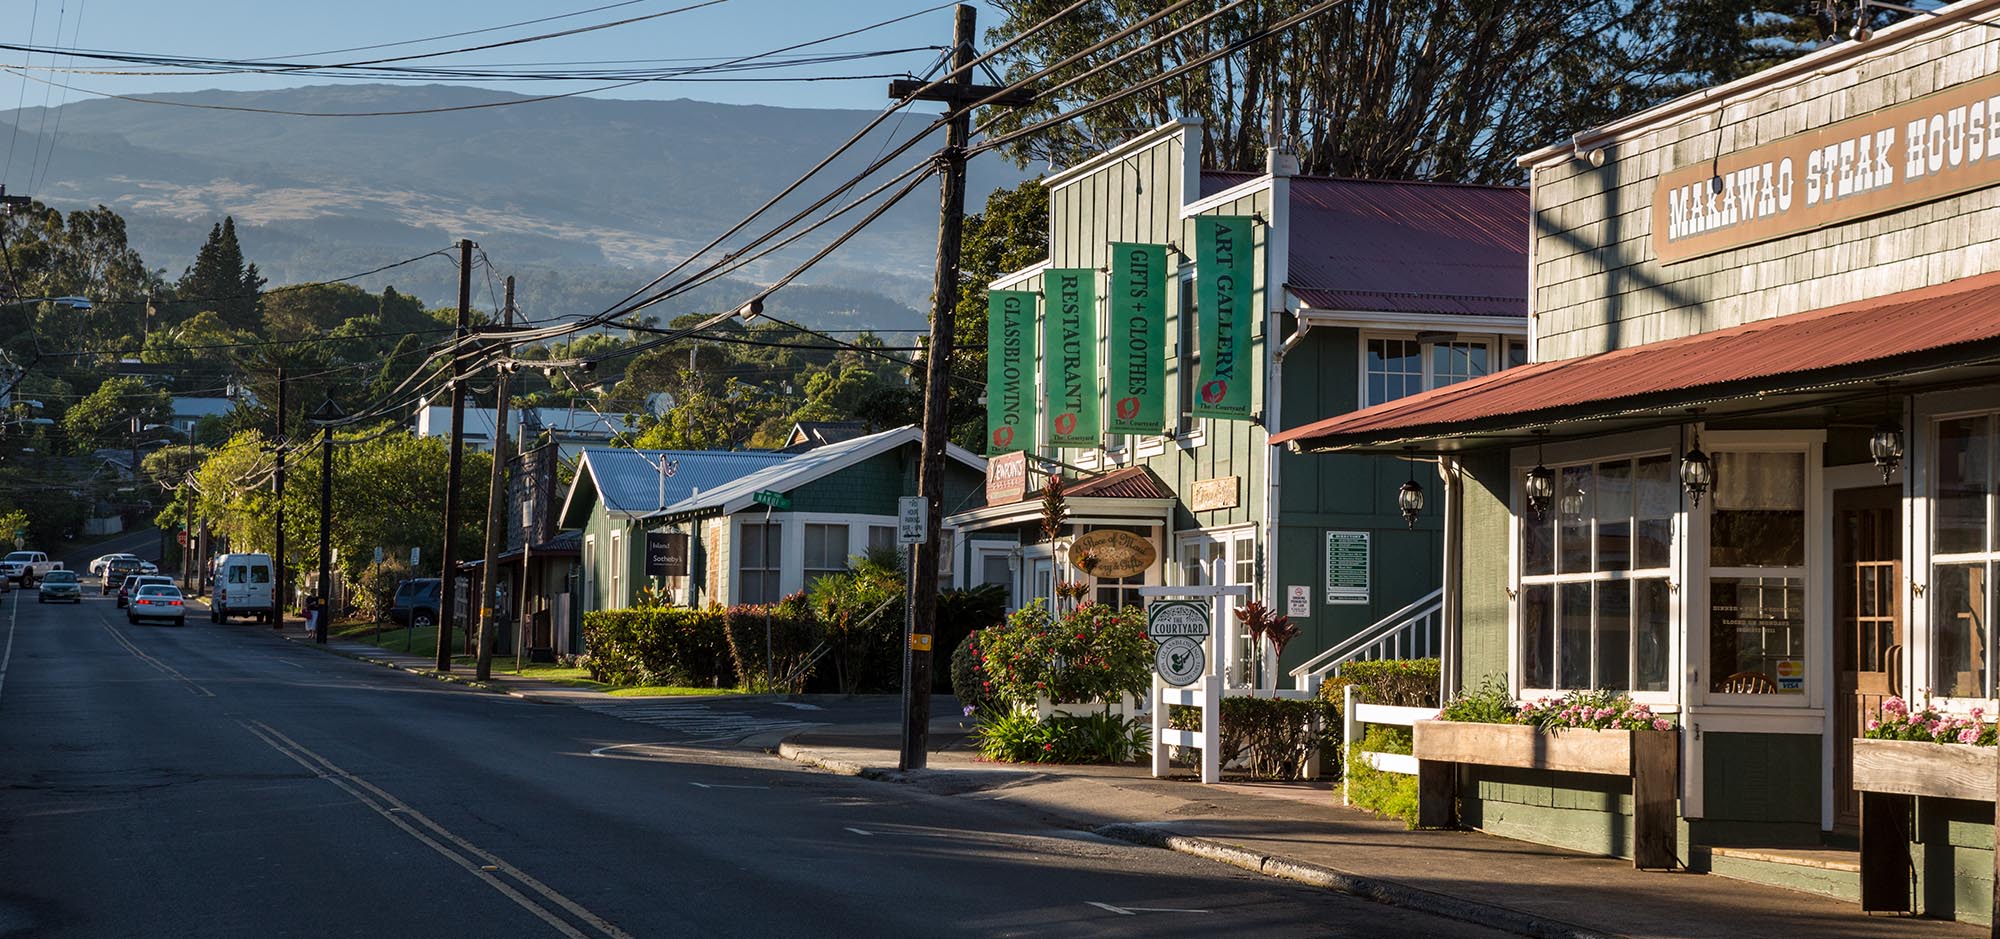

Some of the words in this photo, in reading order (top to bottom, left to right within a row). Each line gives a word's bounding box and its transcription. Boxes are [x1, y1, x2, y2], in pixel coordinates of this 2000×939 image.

[1669, 157, 1794, 241] MAKAWAO
[1807, 127, 1895, 206] STEAK
[1215, 222, 1233, 269] ART
[1130, 250, 1148, 298] GIFTS
[1132, 302, 1147, 312] +
[1216, 274, 1234, 380] GALLERY
[1003, 296, 1021, 425] GLASSBLOWING
[1062, 275, 1081, 413] RESTAURANT
[1129, 316, 1148, 396] CLOTHES
[1215, 403, 1246, 412] Courtyard
[1107, 532, 1117, 547] of
[1155, 623, 1204, 634] COURTYARD
